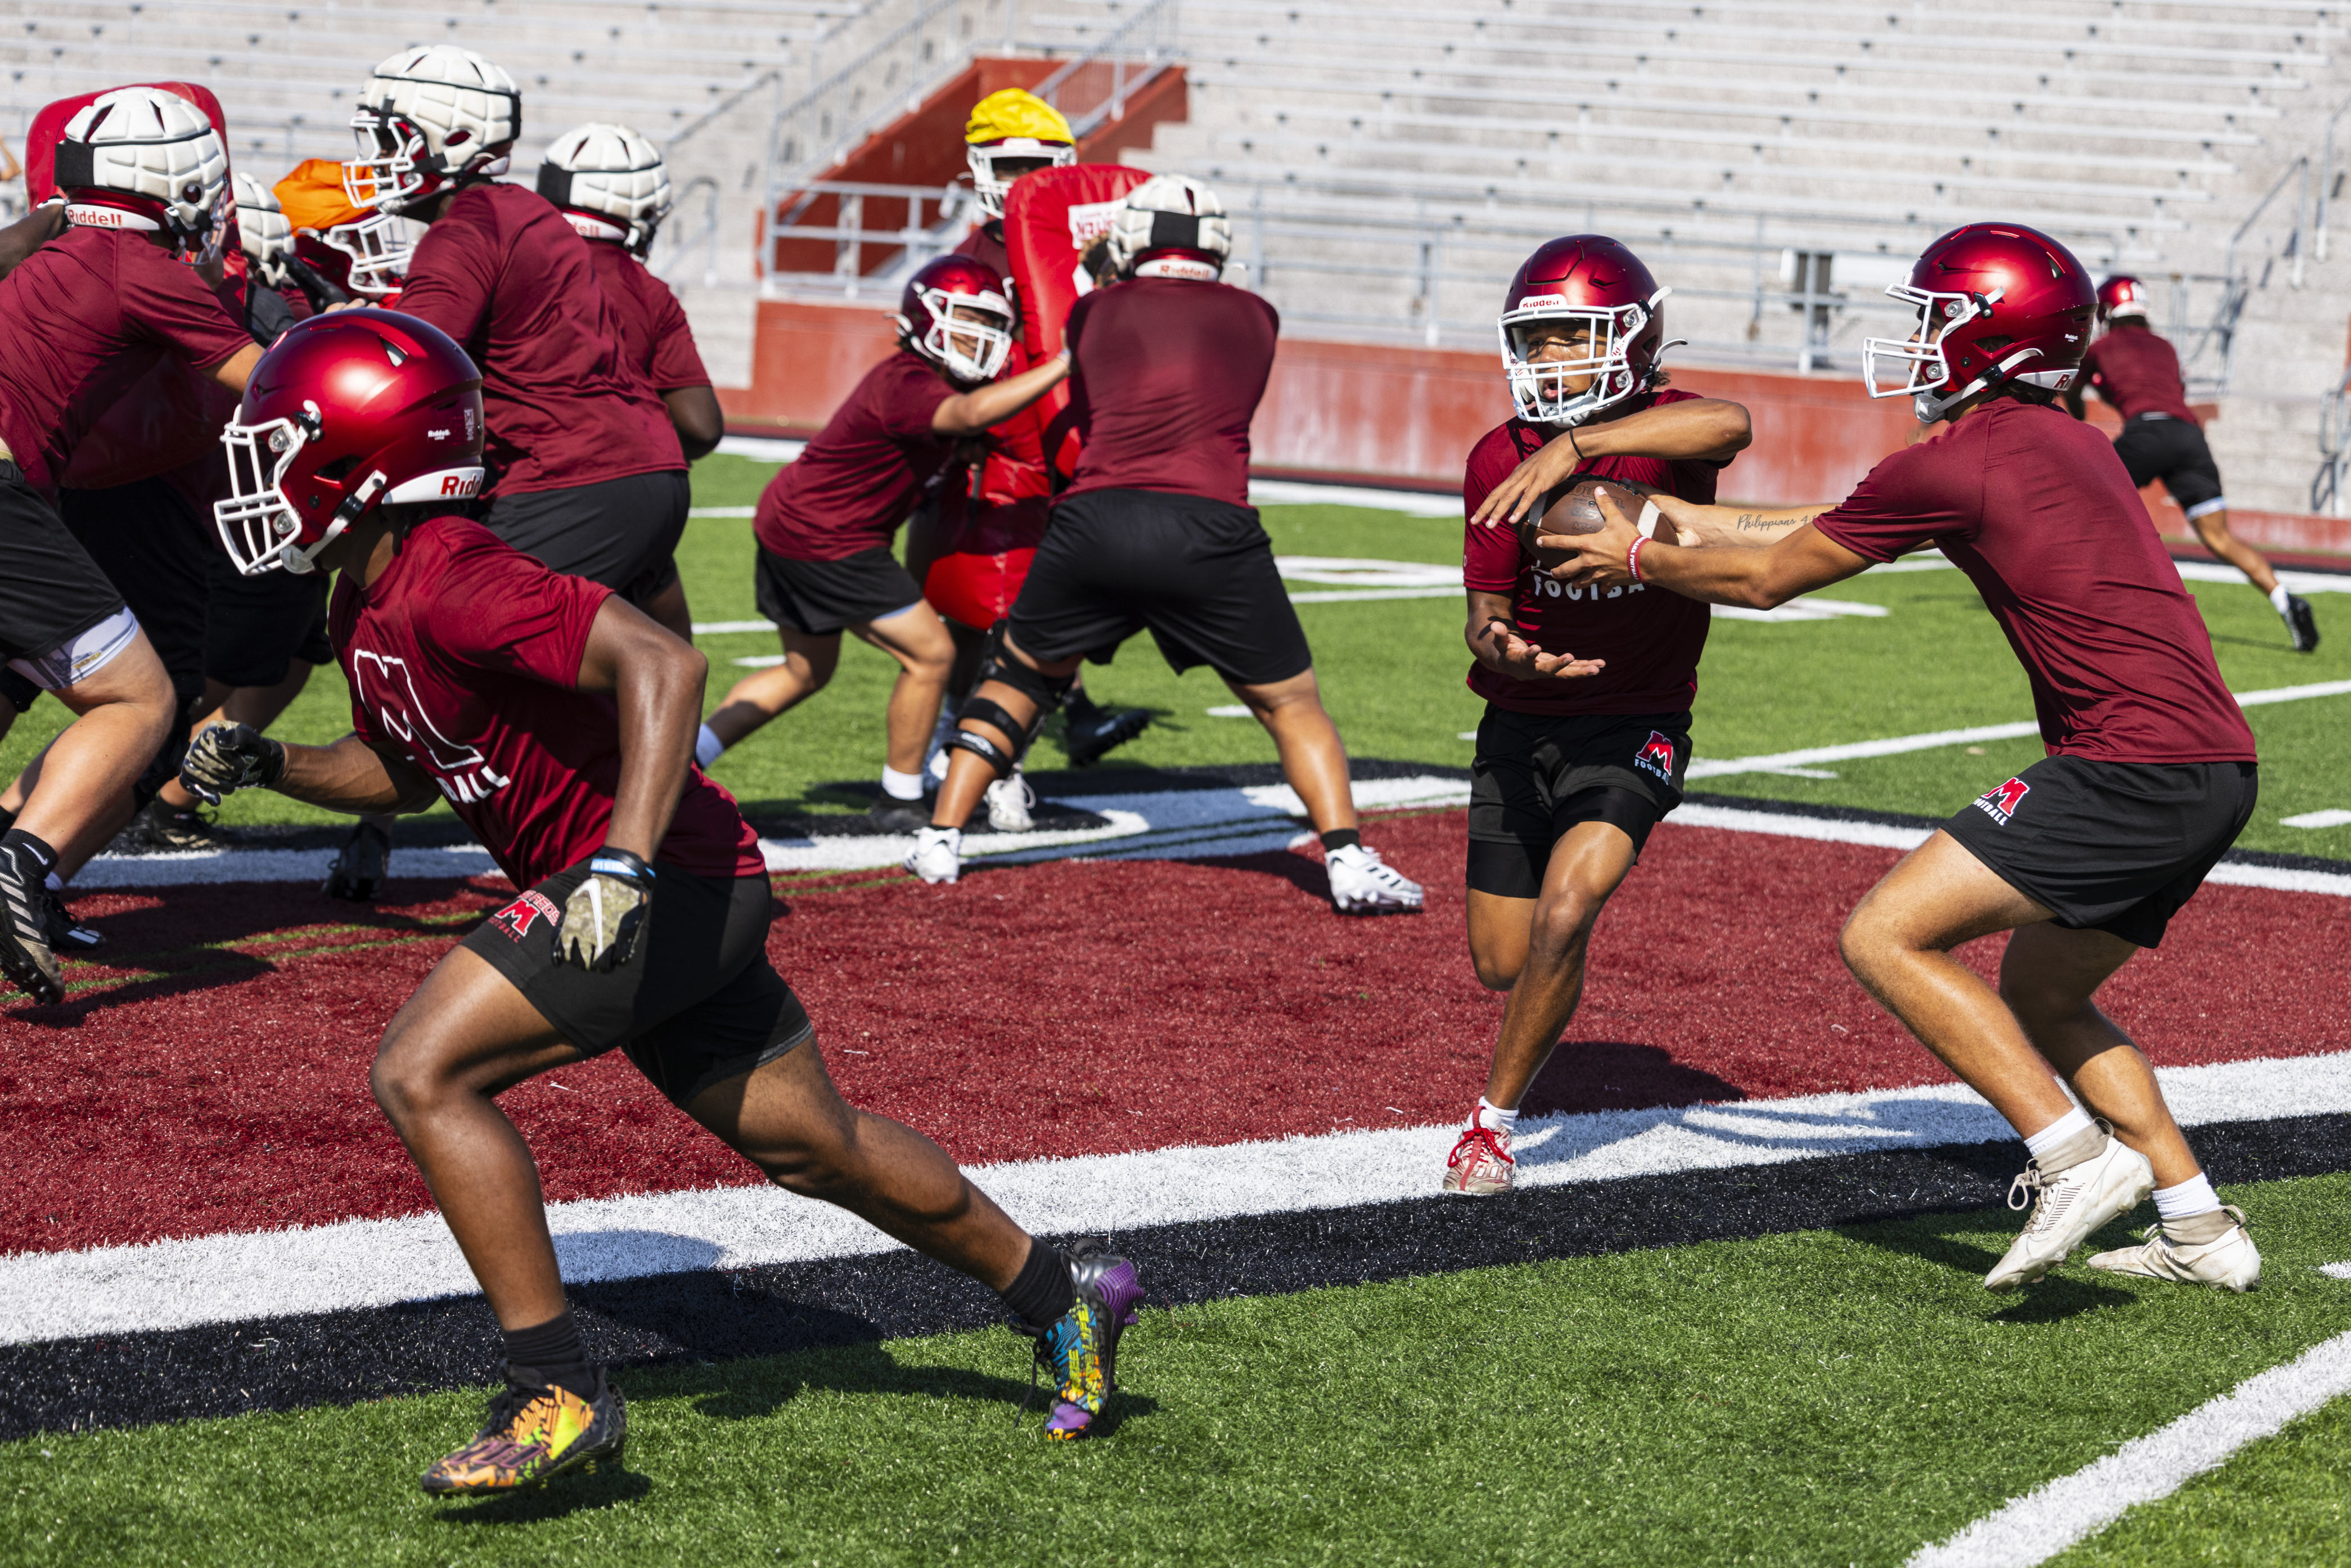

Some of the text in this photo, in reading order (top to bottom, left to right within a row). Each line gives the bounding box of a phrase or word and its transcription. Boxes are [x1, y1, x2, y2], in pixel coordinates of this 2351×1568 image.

[67, 209, 122, 226] Riddell
[440, 475, 483, 495] Ridd
[1737, 513, 1796, 531] Philippians
[1636, 730, 1673, 776] M
[1980, 777, 2030, 817] M
[494, 898, 541, 937] M
[528, 892, 561, 927] REDS
